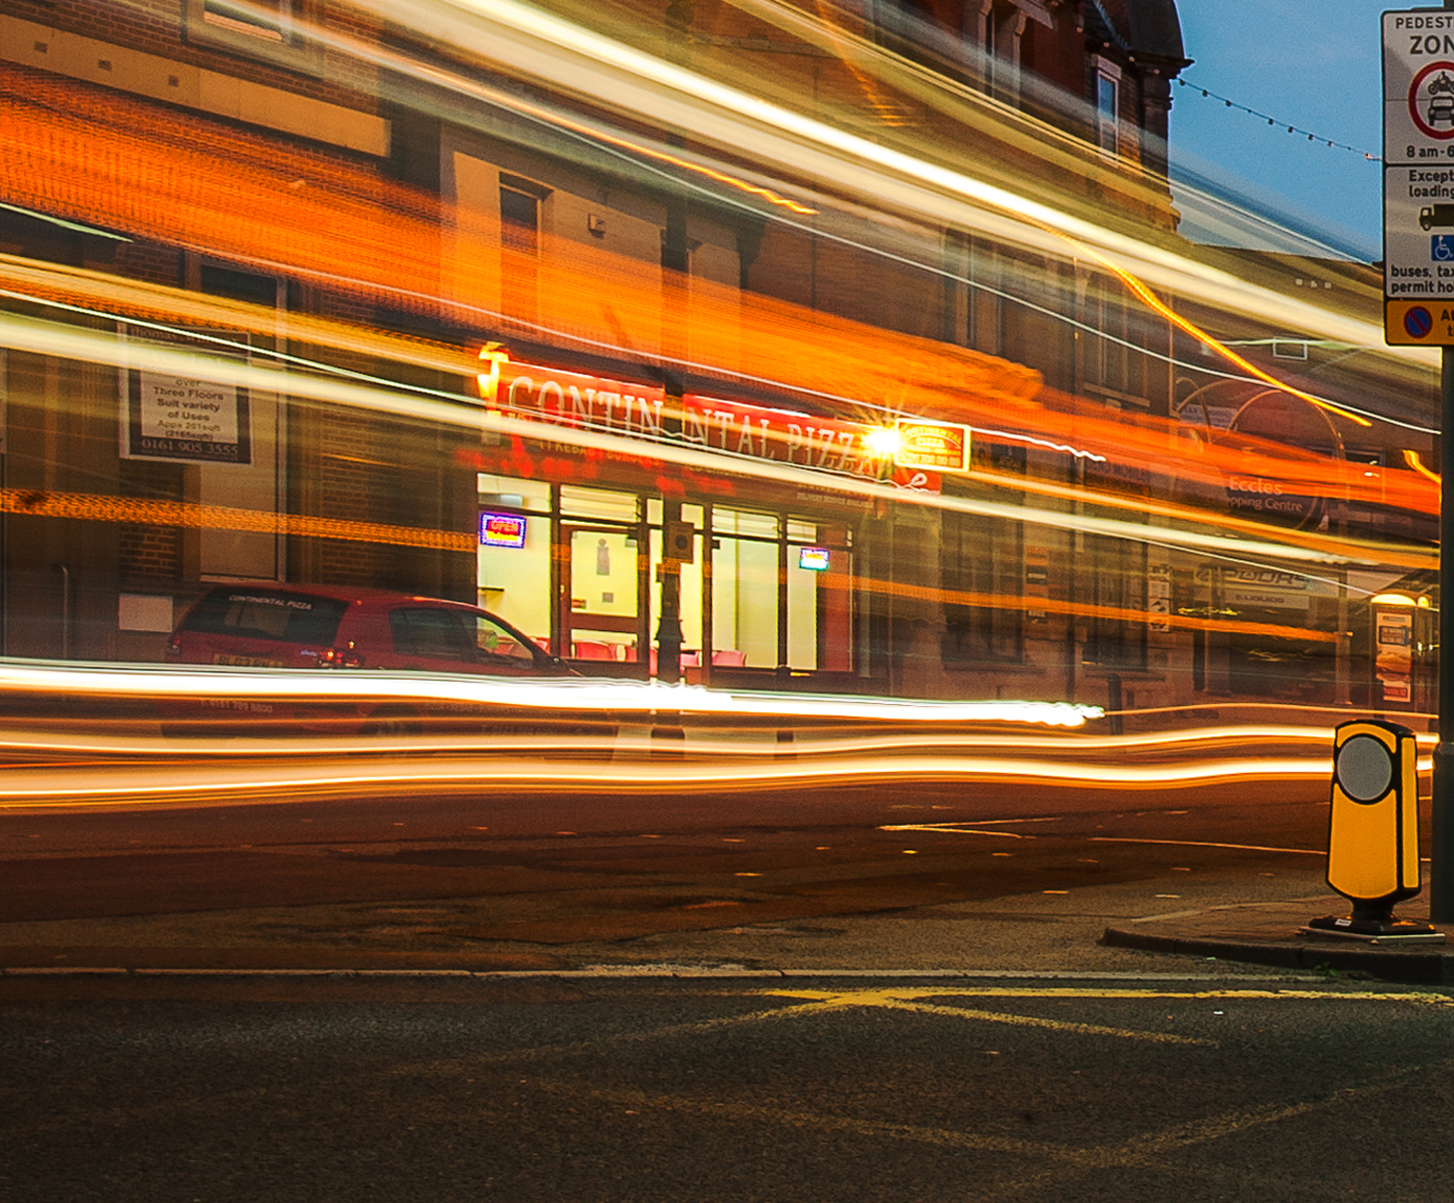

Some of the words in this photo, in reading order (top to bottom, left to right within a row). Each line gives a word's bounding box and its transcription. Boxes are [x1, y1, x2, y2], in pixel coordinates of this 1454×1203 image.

[1406, 145, 1415, 157] 8
[1418, 147, 1438, 157] am
[1408, 170, 1454, 184] Except
[1391, 281, 1434, 294] permit
[153, 386, 186, 396] Three
[188, 389, 224, 400] Floors
[157, 398, 180, 407] Suit
[182, 401, 220, 412] variety
[182, 411, 210, 421] Uses
[508, 375, 776, 460] CONTINNTAL
[142, 439, 173, 452] 0161
[180, 441, 202, 454] 905
[1229, 477, 1283, 495] Eccles
[1230, 497, 1262, 511] pping
[1265, 498, 1303, 511] Centre
[286, 601, 312, 610] PIZZA
